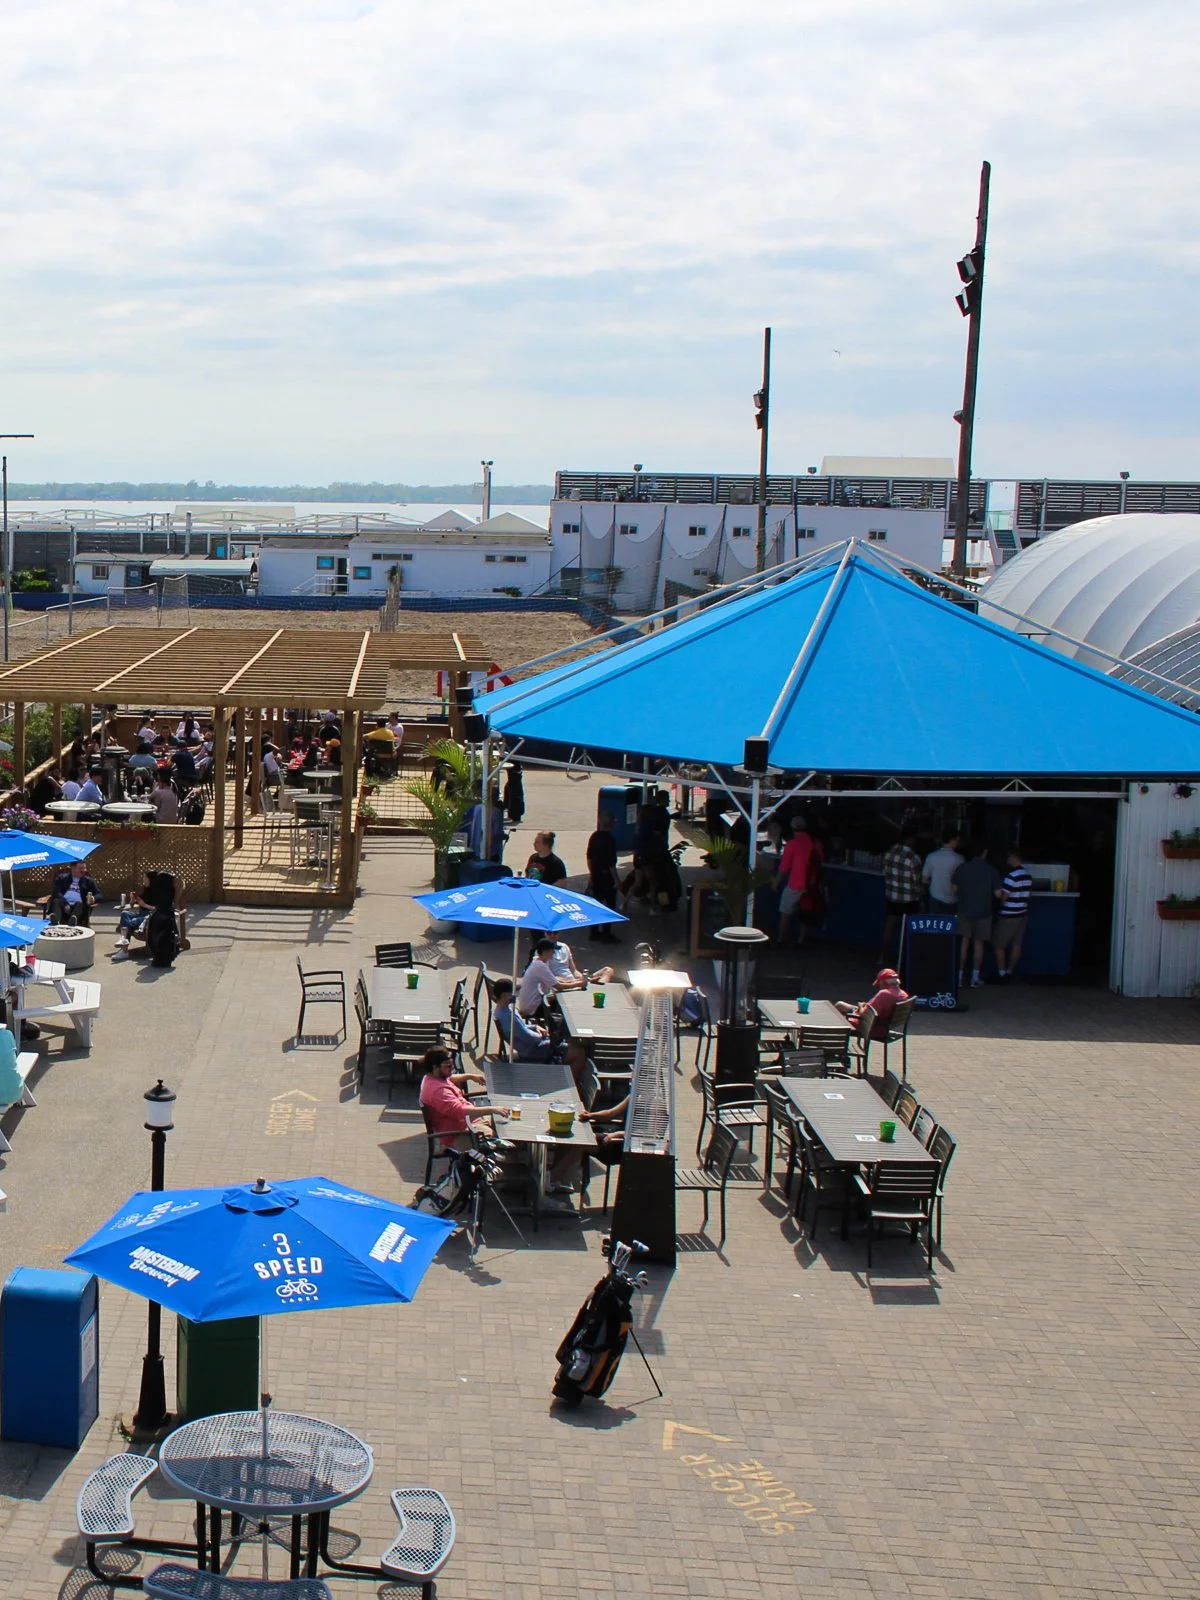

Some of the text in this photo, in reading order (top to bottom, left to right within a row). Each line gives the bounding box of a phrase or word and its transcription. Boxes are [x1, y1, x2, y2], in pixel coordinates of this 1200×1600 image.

[272, 1232, 292, 1257] 3
[369, 1221, 406, 1263] AMSTERDAM
[129, 1245, 200, 1282] AMSTERDAM
[129, 1259, 179, 1288] Brewery
[253, 1256, 323, 1280] SPEED
[679, 1453, 795, 1535] SOCCER
[726, 1458, 817, 1516] DOME
